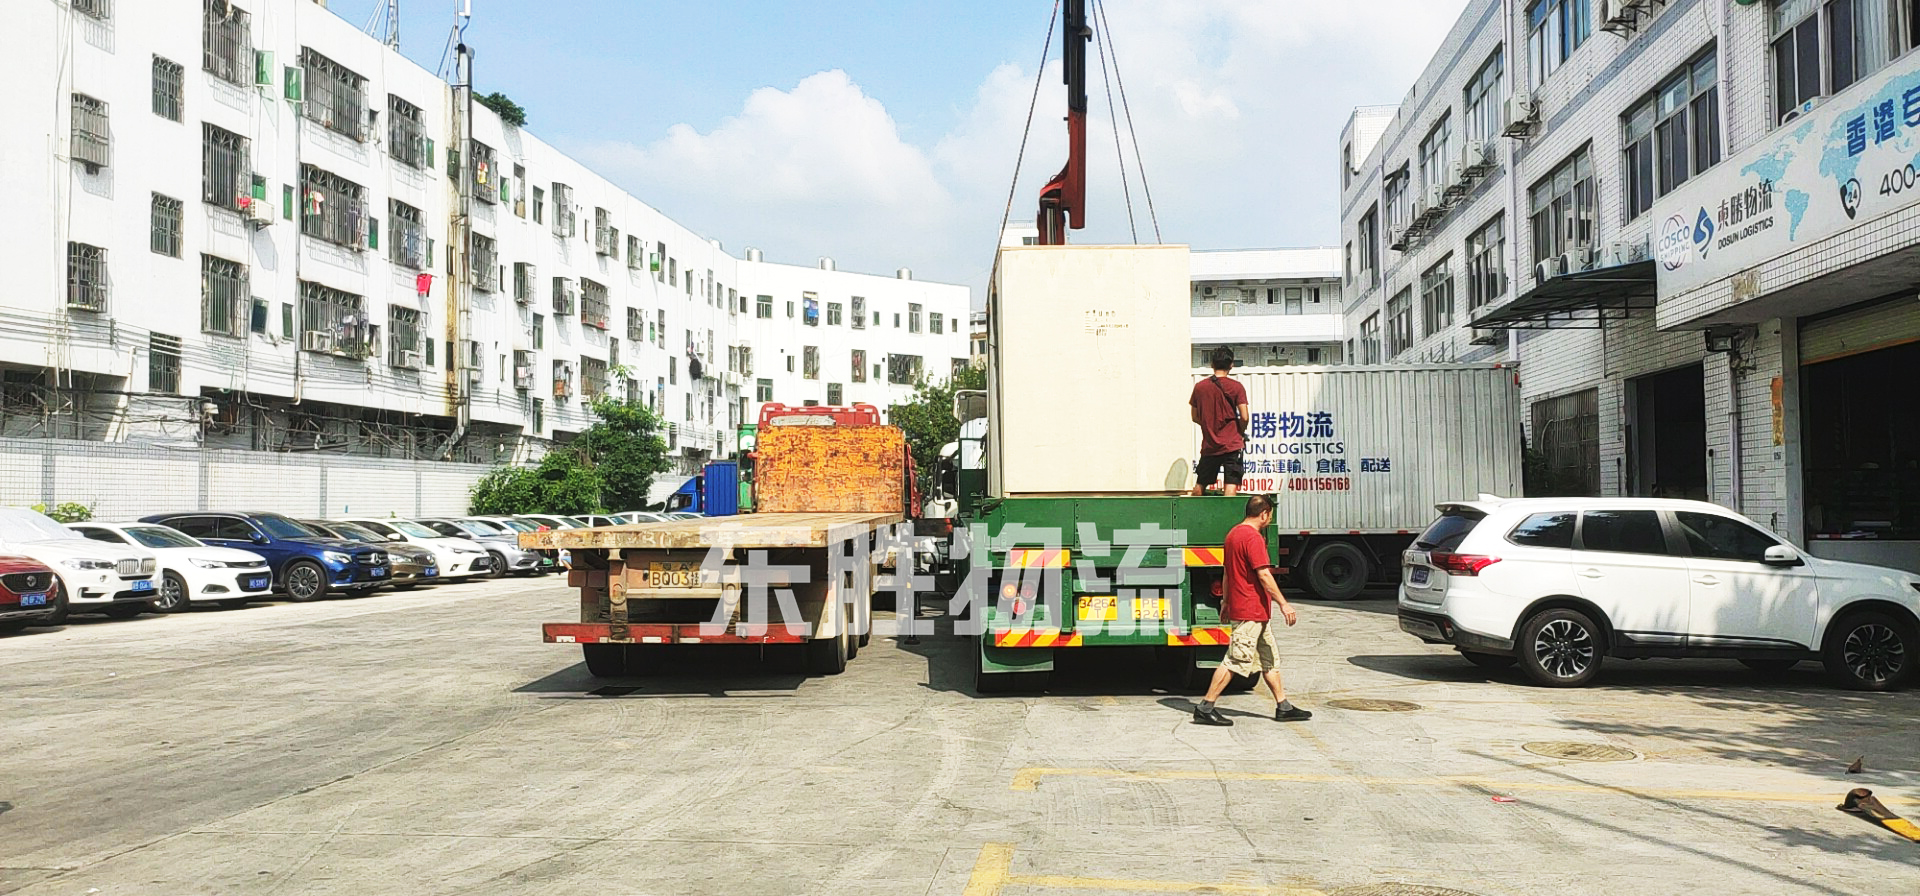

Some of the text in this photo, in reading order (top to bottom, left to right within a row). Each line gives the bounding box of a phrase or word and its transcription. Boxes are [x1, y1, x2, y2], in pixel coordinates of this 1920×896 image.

[1717, 178, 1773, 232] 東勝物流
[1658, 225, 1690, 252] COSCO
[1717, 216, 1774, 250] DOSUN LOGISTICS
[1660, 241, 1690, 263] SHIPPING
[1251, 411, 1334, 438] 勝物流
[1244, 442, 1344, 455] UN LOGISTICS
[1288, 477, 1350, 491] 4001156168
[1079, 598, 1116, 609] 34264
[1142, 599, 1159, 608] PE
[1094, 608, 1102, 618] T
